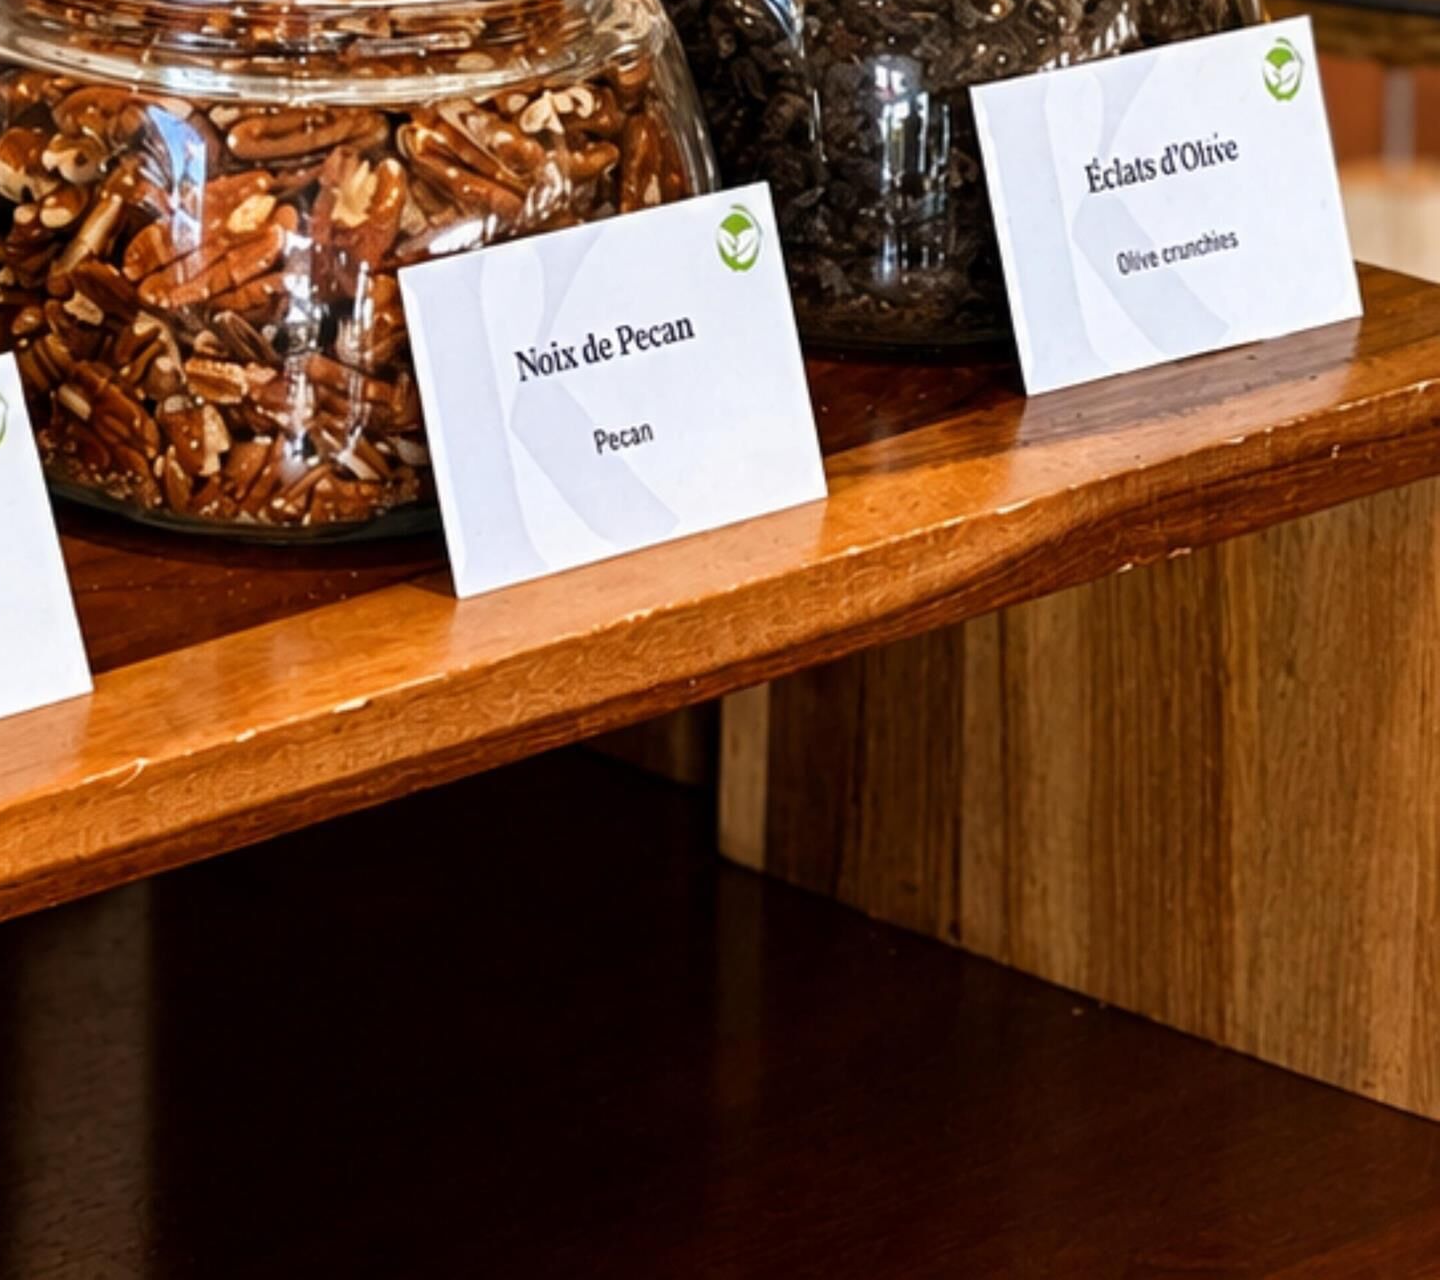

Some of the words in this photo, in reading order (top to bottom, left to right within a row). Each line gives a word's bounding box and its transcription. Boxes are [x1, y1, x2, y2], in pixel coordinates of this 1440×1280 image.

[1082, 155, 1159, 195] Éclats
[1115, 248, 1161, 277] Olive
[1161, 228, 1241, 266] crunchies
[512, 338, 580, 384] Noix
[581, 331, 616, 366] de
[616, 314, 698, 358] Pecan
[591, 419, 656, 456] Pecan
